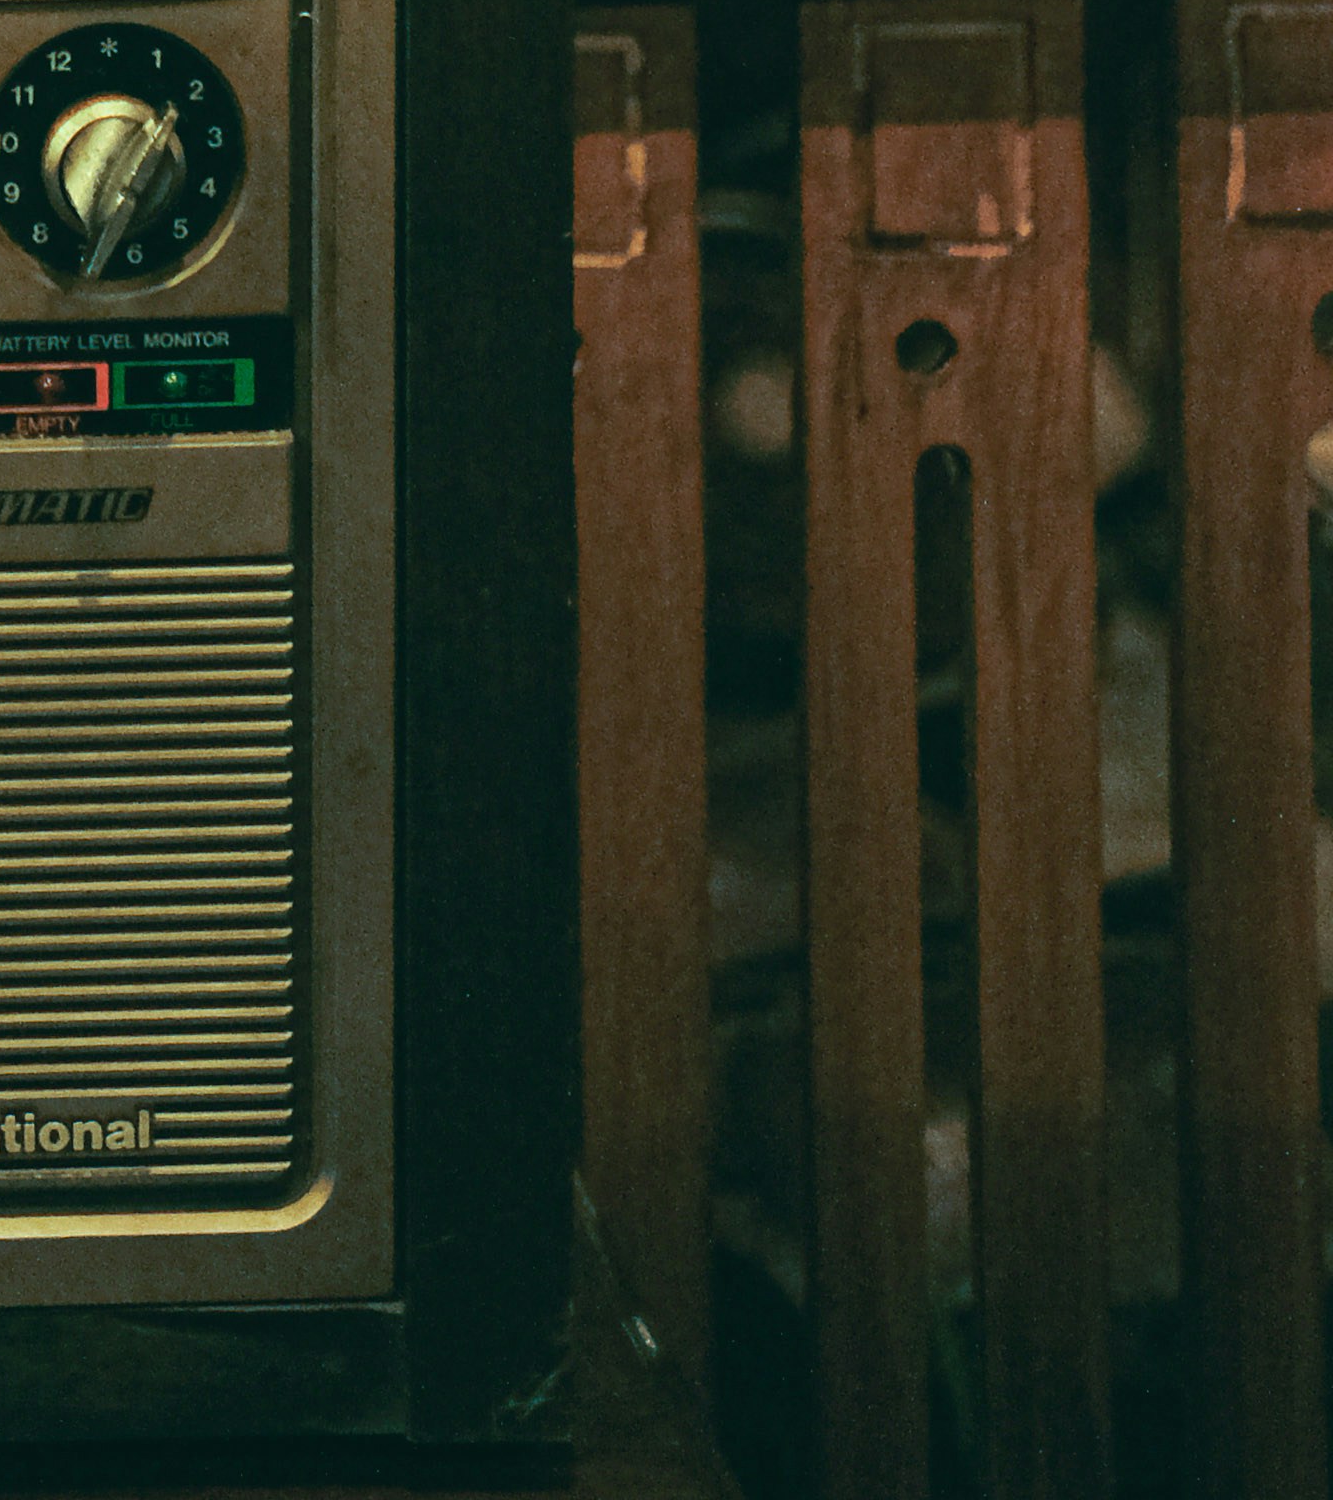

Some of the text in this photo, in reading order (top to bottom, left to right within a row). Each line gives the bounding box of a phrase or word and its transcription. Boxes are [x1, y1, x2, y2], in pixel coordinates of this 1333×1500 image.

[47, 51, 72, 72] 12
[152, 49, 162, 69] 1
[11, 85, 34, 106] 11
[189, 80, 204, 100] 2
[207, 126, 223, 148] 3
[3, 182, 21, 204] 9
[200, 177, 217, 198] 4
[32, 222, 49, 244] 8
[172, 218, 189, 239] 5
[127, 243, 143, 264] 6
[77, 333, 134, 350] LEVEL
[143, 331, 230, 348] MONITOR
[16, 415, 81, 433] EMPTY
[151, 412, 194, 428] FULL
